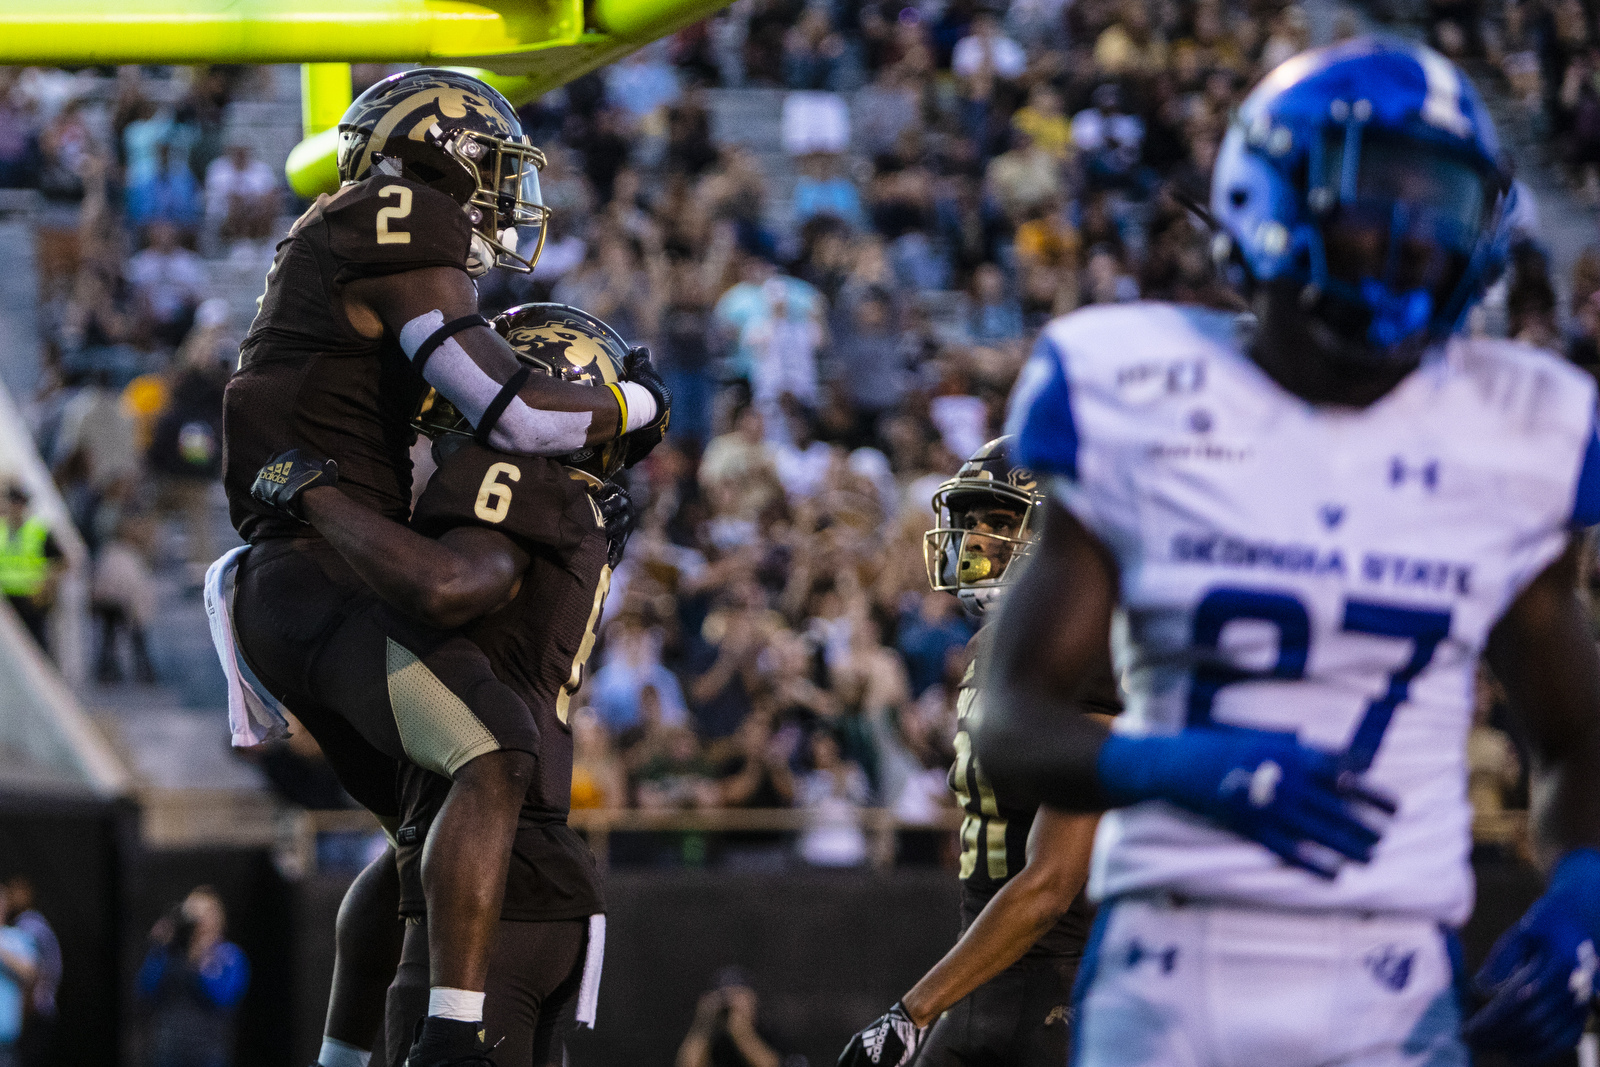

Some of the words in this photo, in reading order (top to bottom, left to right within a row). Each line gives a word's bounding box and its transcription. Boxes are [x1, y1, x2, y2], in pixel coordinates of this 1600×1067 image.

[376, 185, 413, 244] 2
[260, 471, 289, 484] adidas
[474, 462, 521, 524] 6
[1362, 554, 1474, 596] STATE
[1187, 584, 1453, 777] 27
[871, 1022, 890, 1064] adidas
